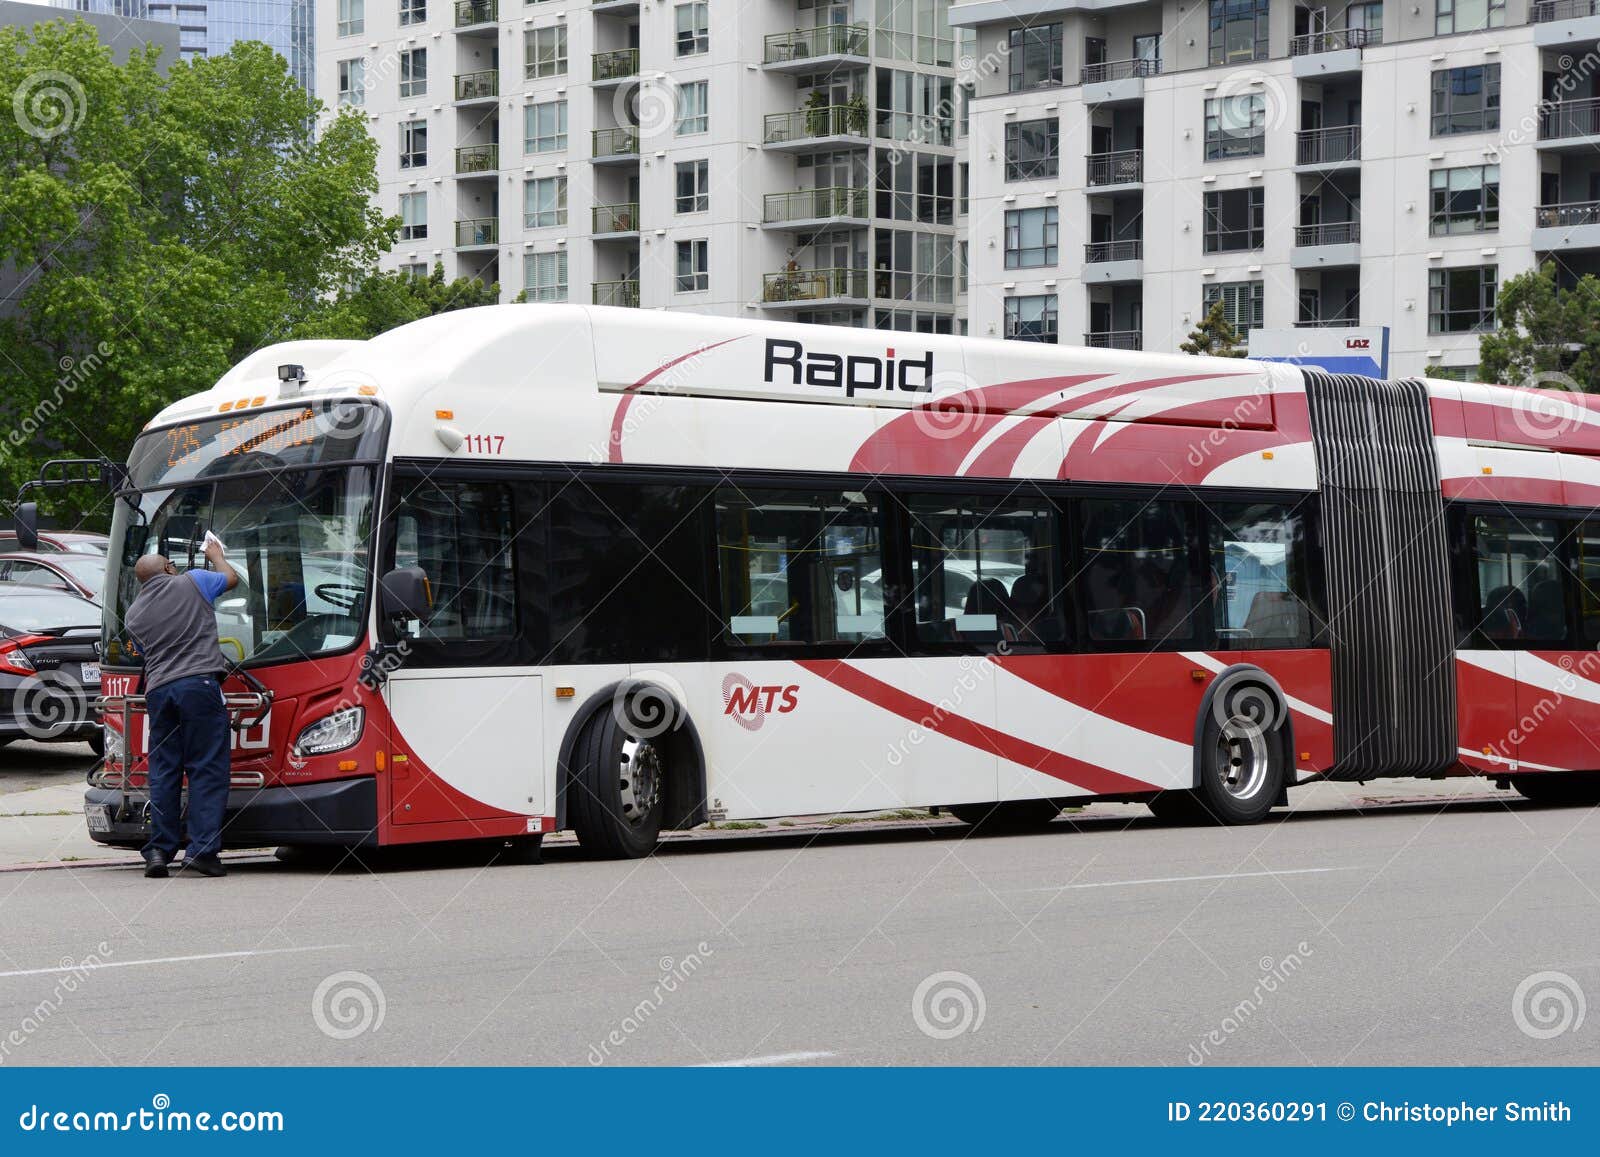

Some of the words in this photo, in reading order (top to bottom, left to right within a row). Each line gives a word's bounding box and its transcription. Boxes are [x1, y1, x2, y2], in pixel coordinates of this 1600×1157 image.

[1346, 339, 1370, 349] LAZ
[764, 338, 934, 397] Rapid
[168, 425, 200, 467] 235
[464, 434, 505, 455] 1117
[107, 677, 130, 697] 1117
[724, 685, 800, 715] MTS
